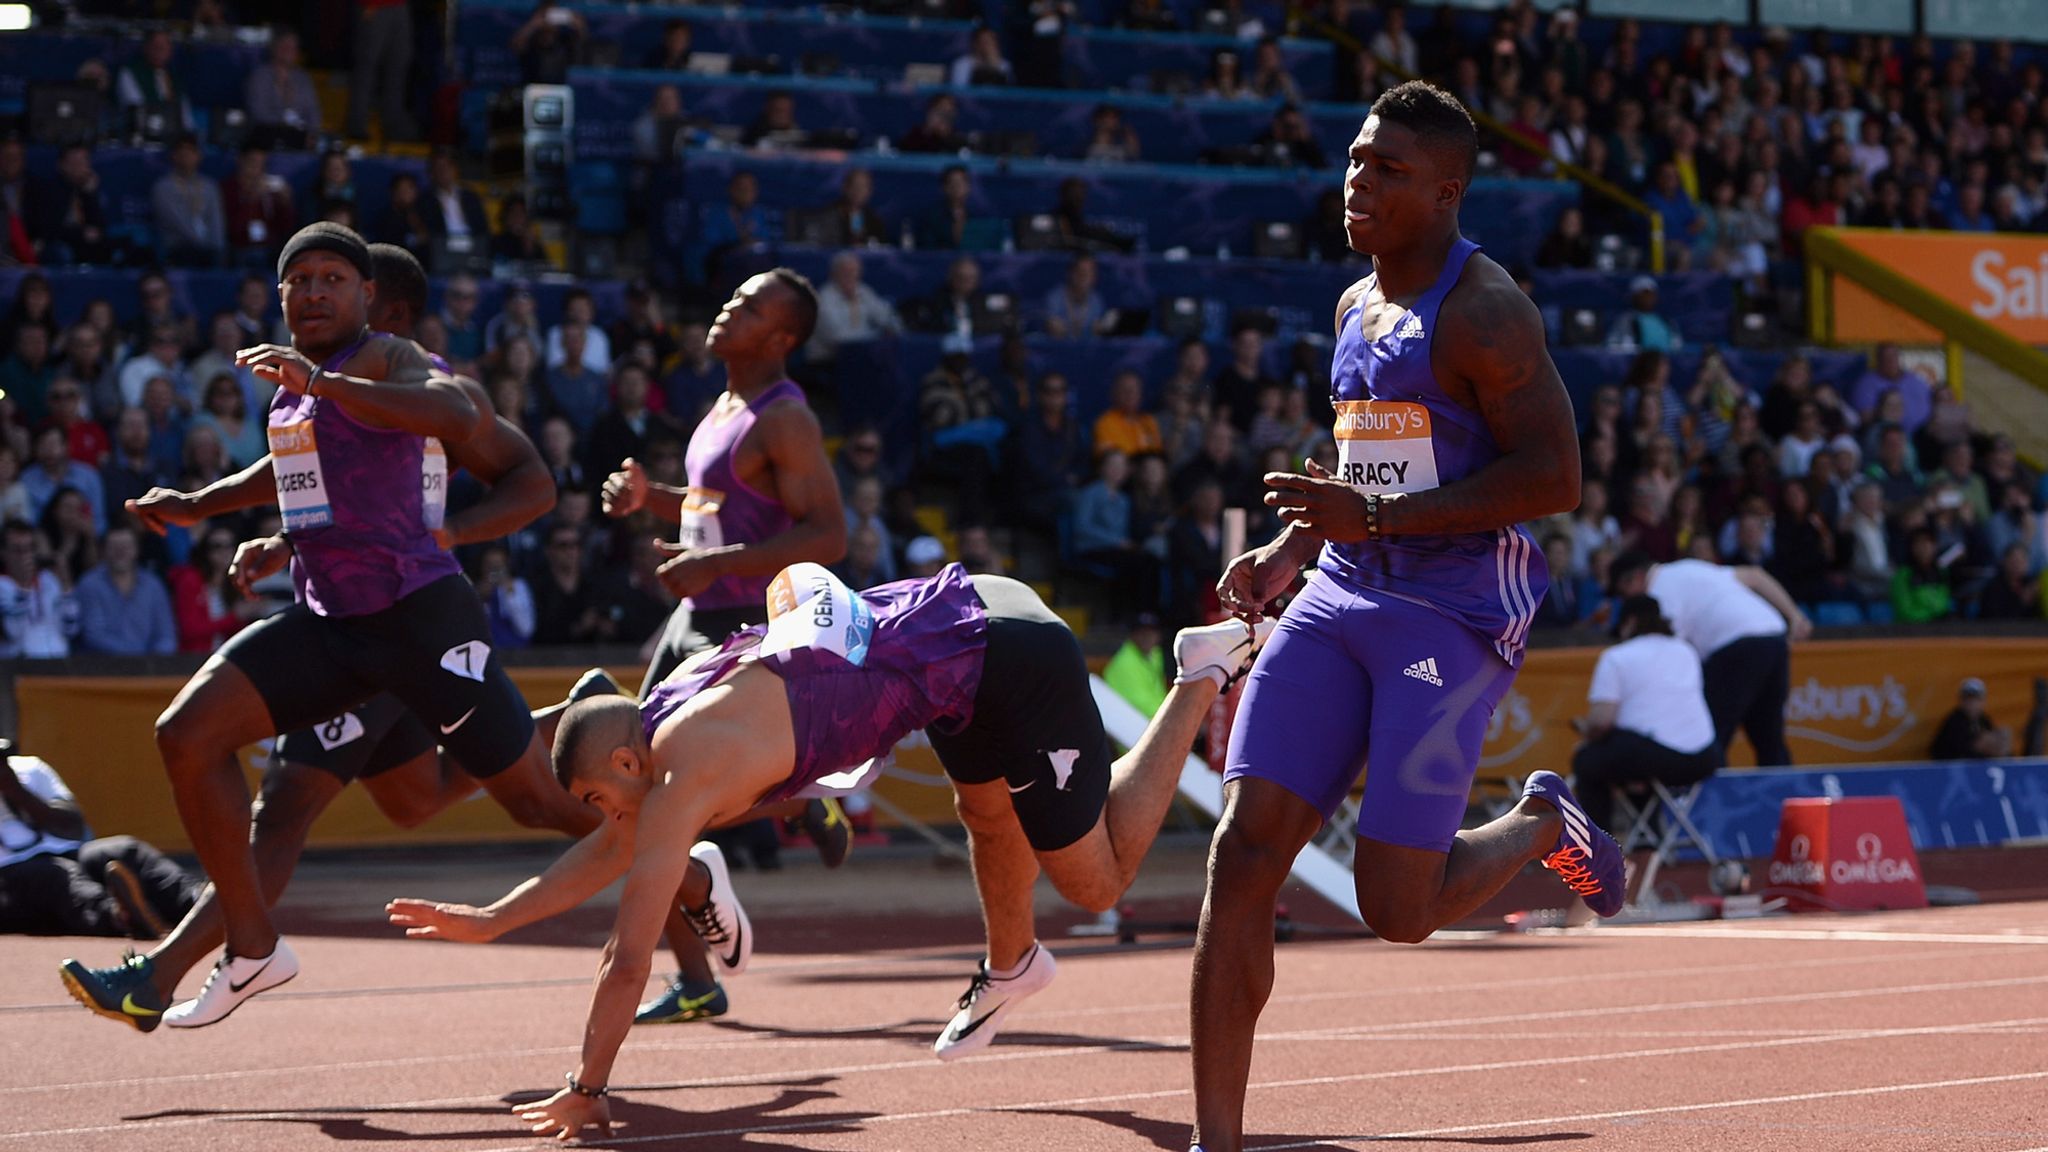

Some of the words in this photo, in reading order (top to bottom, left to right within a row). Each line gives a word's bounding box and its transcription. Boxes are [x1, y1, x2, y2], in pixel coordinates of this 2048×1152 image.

[1396, 330, 1425, 339] adidas
[1343, 461, 1409, 485] BRACY
[456, 645, 473, 677] 7
[1403, 667, 1443, 687] adidas
[323, 715, 346, 742] 8
[1769, 860, 1825, 884] OMEGA
[1830, 858, 1916, 885] OMEGA
